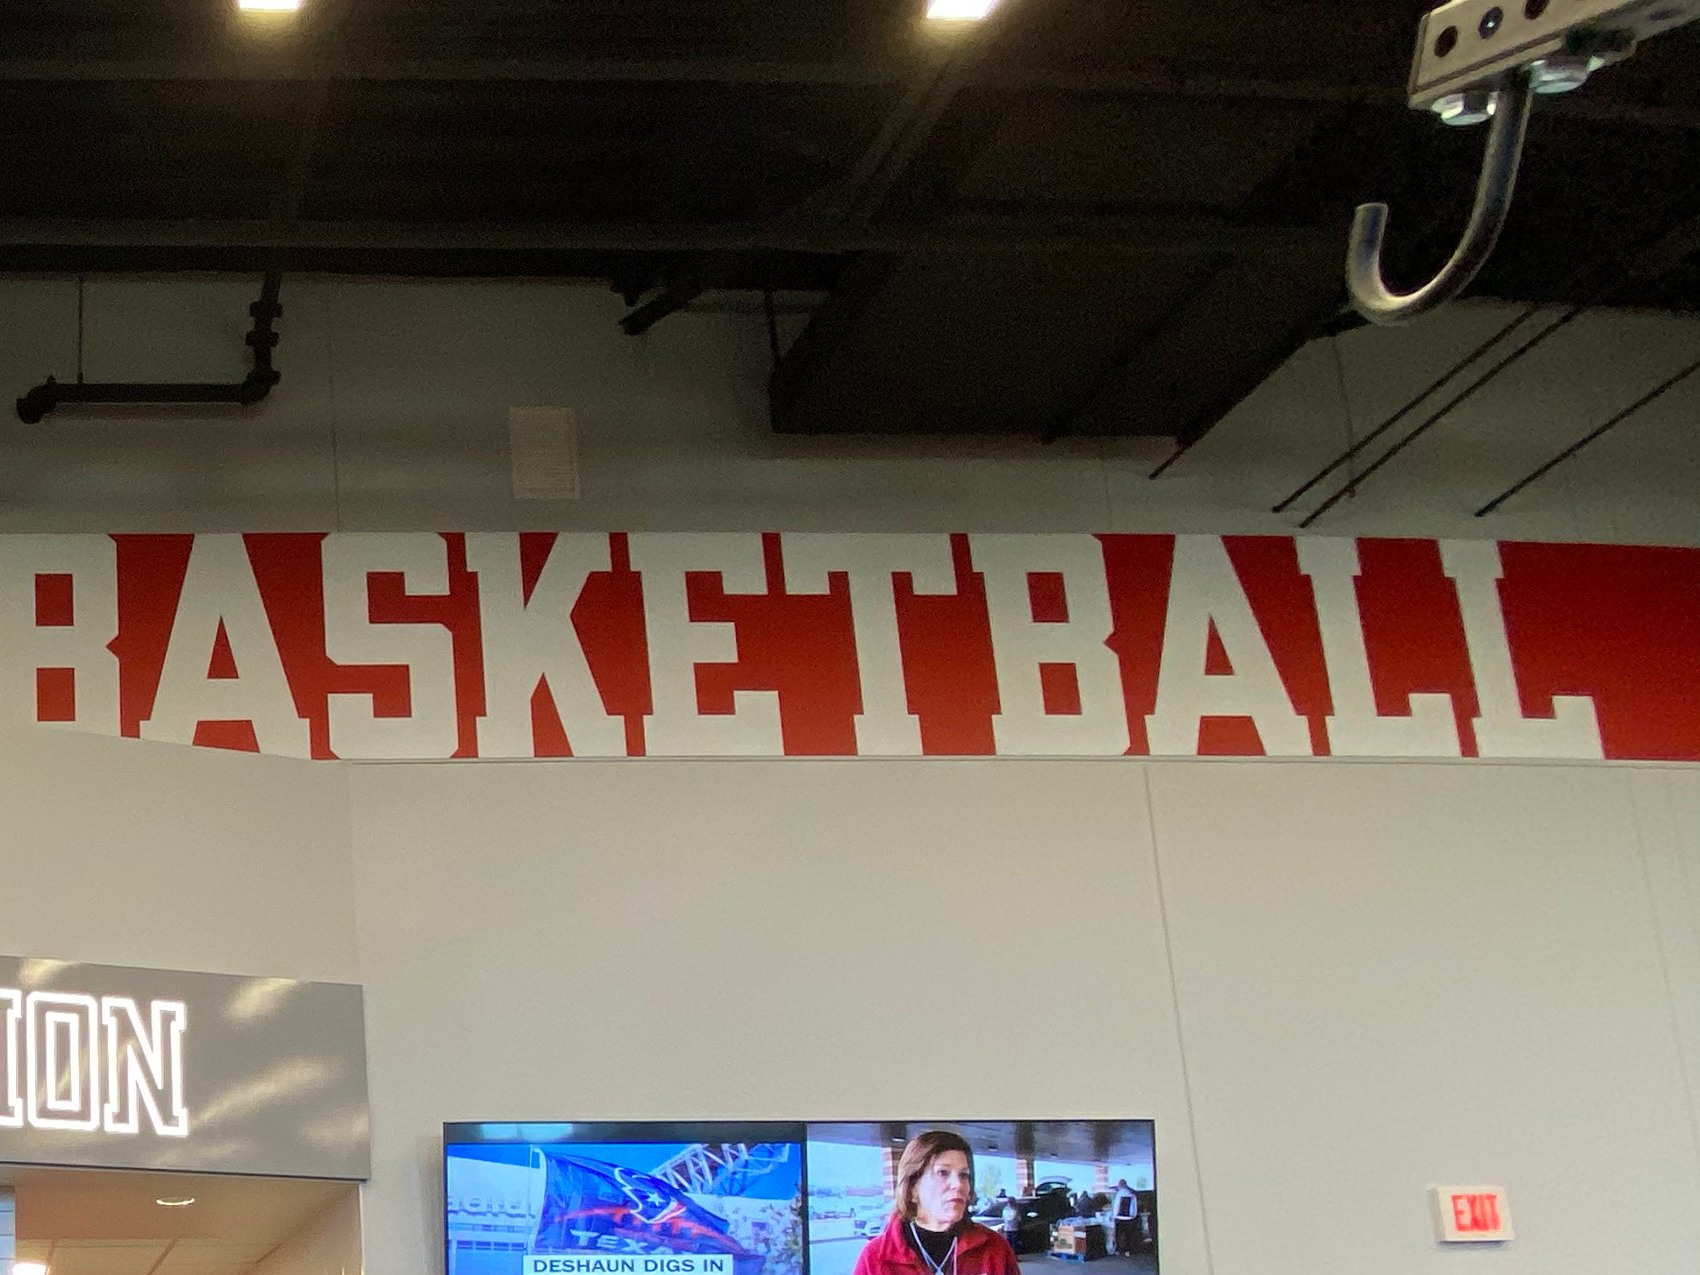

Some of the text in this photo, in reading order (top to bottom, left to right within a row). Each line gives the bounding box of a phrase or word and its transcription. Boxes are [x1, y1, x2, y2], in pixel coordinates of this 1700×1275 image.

[1451, 1193, 1501, 1231] EXIT
[533, 1259, 724, 1273] DESHAUN DIGS IN
